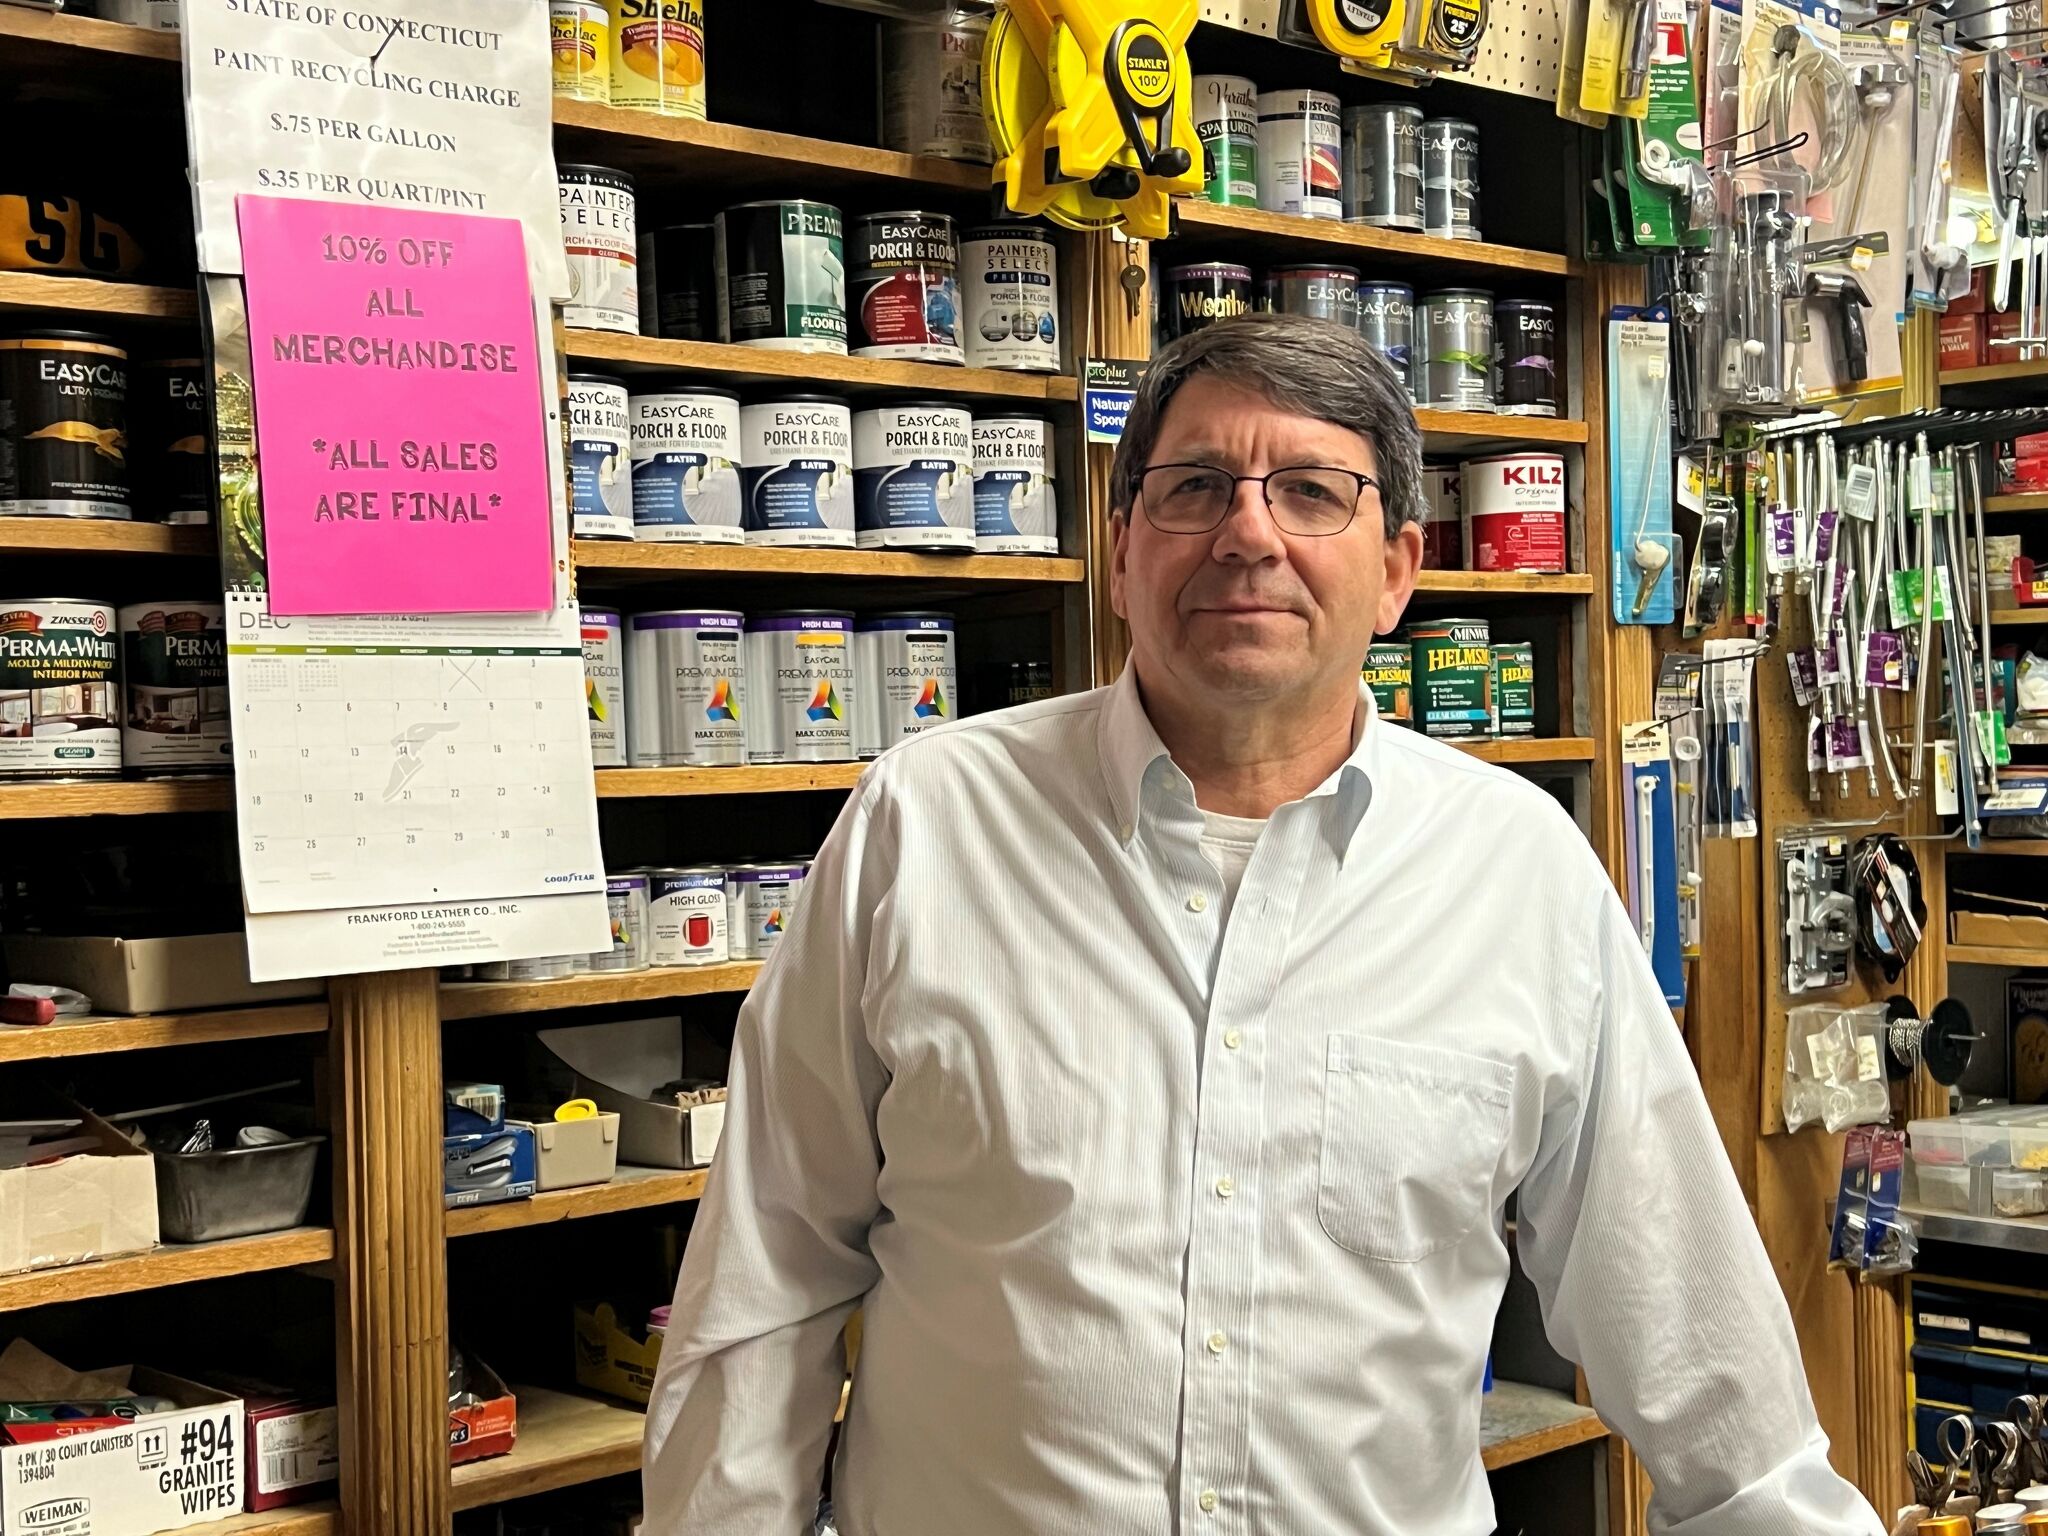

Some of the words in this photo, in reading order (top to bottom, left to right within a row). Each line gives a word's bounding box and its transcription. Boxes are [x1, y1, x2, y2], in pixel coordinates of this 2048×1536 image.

[1346, 4, 1376, 24] STANLEY
[1660, 11, 1683, 20] LEVER
[227, 0, 301, 21] STATE
[306, 5, 335, 26] OF
[343, 11, 503, 51] CONNECTICUT
[1126, 56, 1169, 71] STANLEY
[213, 47, 283, 75] PAINT
[291, 61, 423, 95] RECYCLING
[428, 79, 521, 108] CHARGE
[270, 112, 311, 134] $.75
[317, 116, 361, 140] PER
[367, 124, 457, 153] GALLON
[258, 167, 299, 190] $.35
[307, 172, 351, 194] PER
[357, 178, 487, 210] QUART/PINT
[881, 225, 948, 242] EASYCARE
[322, 233, 387, 264] 10%
[399, 239, 454, 268] OFF
[594, 238, 622, 249] FLOOR
[598, 250, 620, 259] GLOSS
[869, 242, 913, 261] PORCH
[915, 243, 925, 258] &
[927, 244, 957, 262] FLOOR
[987, 259, 1050, 273] SELECT
[992, 274, 1047, 284] PREMIUM
[365, 286, 425, 318] ALL
[990, 293, 1020, 301] PORCH
[1029, 294, 1050, 303] FLOOR
[800, 316, 835, 331] FLOOR
[272, 333, 518, 373] MERCHANDISE
[1087, 366, 1128, 383] proplus
[58, 384, 93, 396] ULTRA
[641, 404, 715, 420] EASYCARE
[1091, 397, 1133, 412] Natural
[594, 411, 603, 425] &
[606, 411, 628, 430] FLOOR
[775, 412, 841, 428] EASYCARE
[897, 414, 961, 429] EASYCARE
[631, 422, 674, 441] PORCH
[677, 422, 687, 439] &
[691, 423, 727, 441] FLOOR
[764, 430, 807, 447] PORCH
[811, 430, 820, 446] &
[822, 431, 848, 448] FLOOR
[972, 426, 1037, 441] EASYCARE
[583, 443, 611, 453] SATIN
[636, 440, 667, 449] URETHANE
[669, 440, 701, 449] FORTIFIED
[886, 431, 928, 448] PORCH
[931, 431, 940, 446] &
[943, 431, 969, 449] FLOOR
[400, 440, 498, 473] SALES
[1005, 443, 1014, 458] &
[1017, 444, 1047, 459] FLOOR
[665, 455, 697, 464] SATIN
[800, 461, 829, 470] SATIN
[920, 461, 949, 470] SATIN
[994, 472, 1023, 481] SATIN
[1503, 466, 1562, 486] KILZ
[1515, 487, 1557, 498] Original
[313, 491, 380, 523] ARE
[50, 616, 95, 626] ZINSSER
[239, 611, 291, 629] DEC
[801, 620, 821, 629] HIGH
[822, 620, 843, 629] GLOSS
[239, 633, 260, 641] 2022
[7, 658, 40, 668] MOLD
[42, 659, 51, 668] &
[1368, 654, 1404, 665] MINWAX
[33, 670, 80, 680] INTERIOR
[82, 670, 104, 680] PAINT
[535, 701, 543, 710] 10
[694, 731, 714, 739] MAX
[795, 730, 815, 738] MAX
[249, 749, 257, 759] 11
[301, 749, 309, 758] 12
[351, 747, 359, 757] 13
[399, 746, 408, 755] 14
[447, 745, 455, 754] 15
[494, 744, 502, 753] 16
[538, 743, 546, 752] 17
[252, 796, 261, 806] 18
[304, 794, 313, 803] 19
[354, 792, 364, 801] 20
[403, 790, 412, 800] 21
[450, 788, 460, 798] 22
[497, 787, 506, 797] 23
[542, 786, 551, 794] 24
[254, 842, 265, 851] 25
[306, 839, 316, 849] 26
[357, 837, 366, 847] 27
[406, 834, 416, 844] 28
[454, 832, 463, 841] 29
[500, 830, 510, 839] 30
[546, 828, 554, 837] 31
[544, 872, 595, 883] GOODYEAR
[664, 877, 725, 891] premiumdecor
[669, 895, 696, 906] HIGH
[697, 893, 721, 905] GLOSS
[347, 911, 419, 925] FRANKFORD
[421, 907, 471, 920] LEATHER
[499, 904, 522, 915] INC.
[180, 1414, 234, 1466] #94
[17, 1454, 23, 1467] 4
[26, 1452, 37, 1467] PK
[45, 1447, 56, 1463] 30
[58, 1442, 89, 1461] COUNT
[90, 1432, 135, 1455] CANISTERS
[18, 1464, 55, 1484] 1394804
[158, 1457, 235, 1494] GRANITE
[180, 1483, 236, 1516] WIPES
[24, 1500, 84, 1524] WEIMAN
